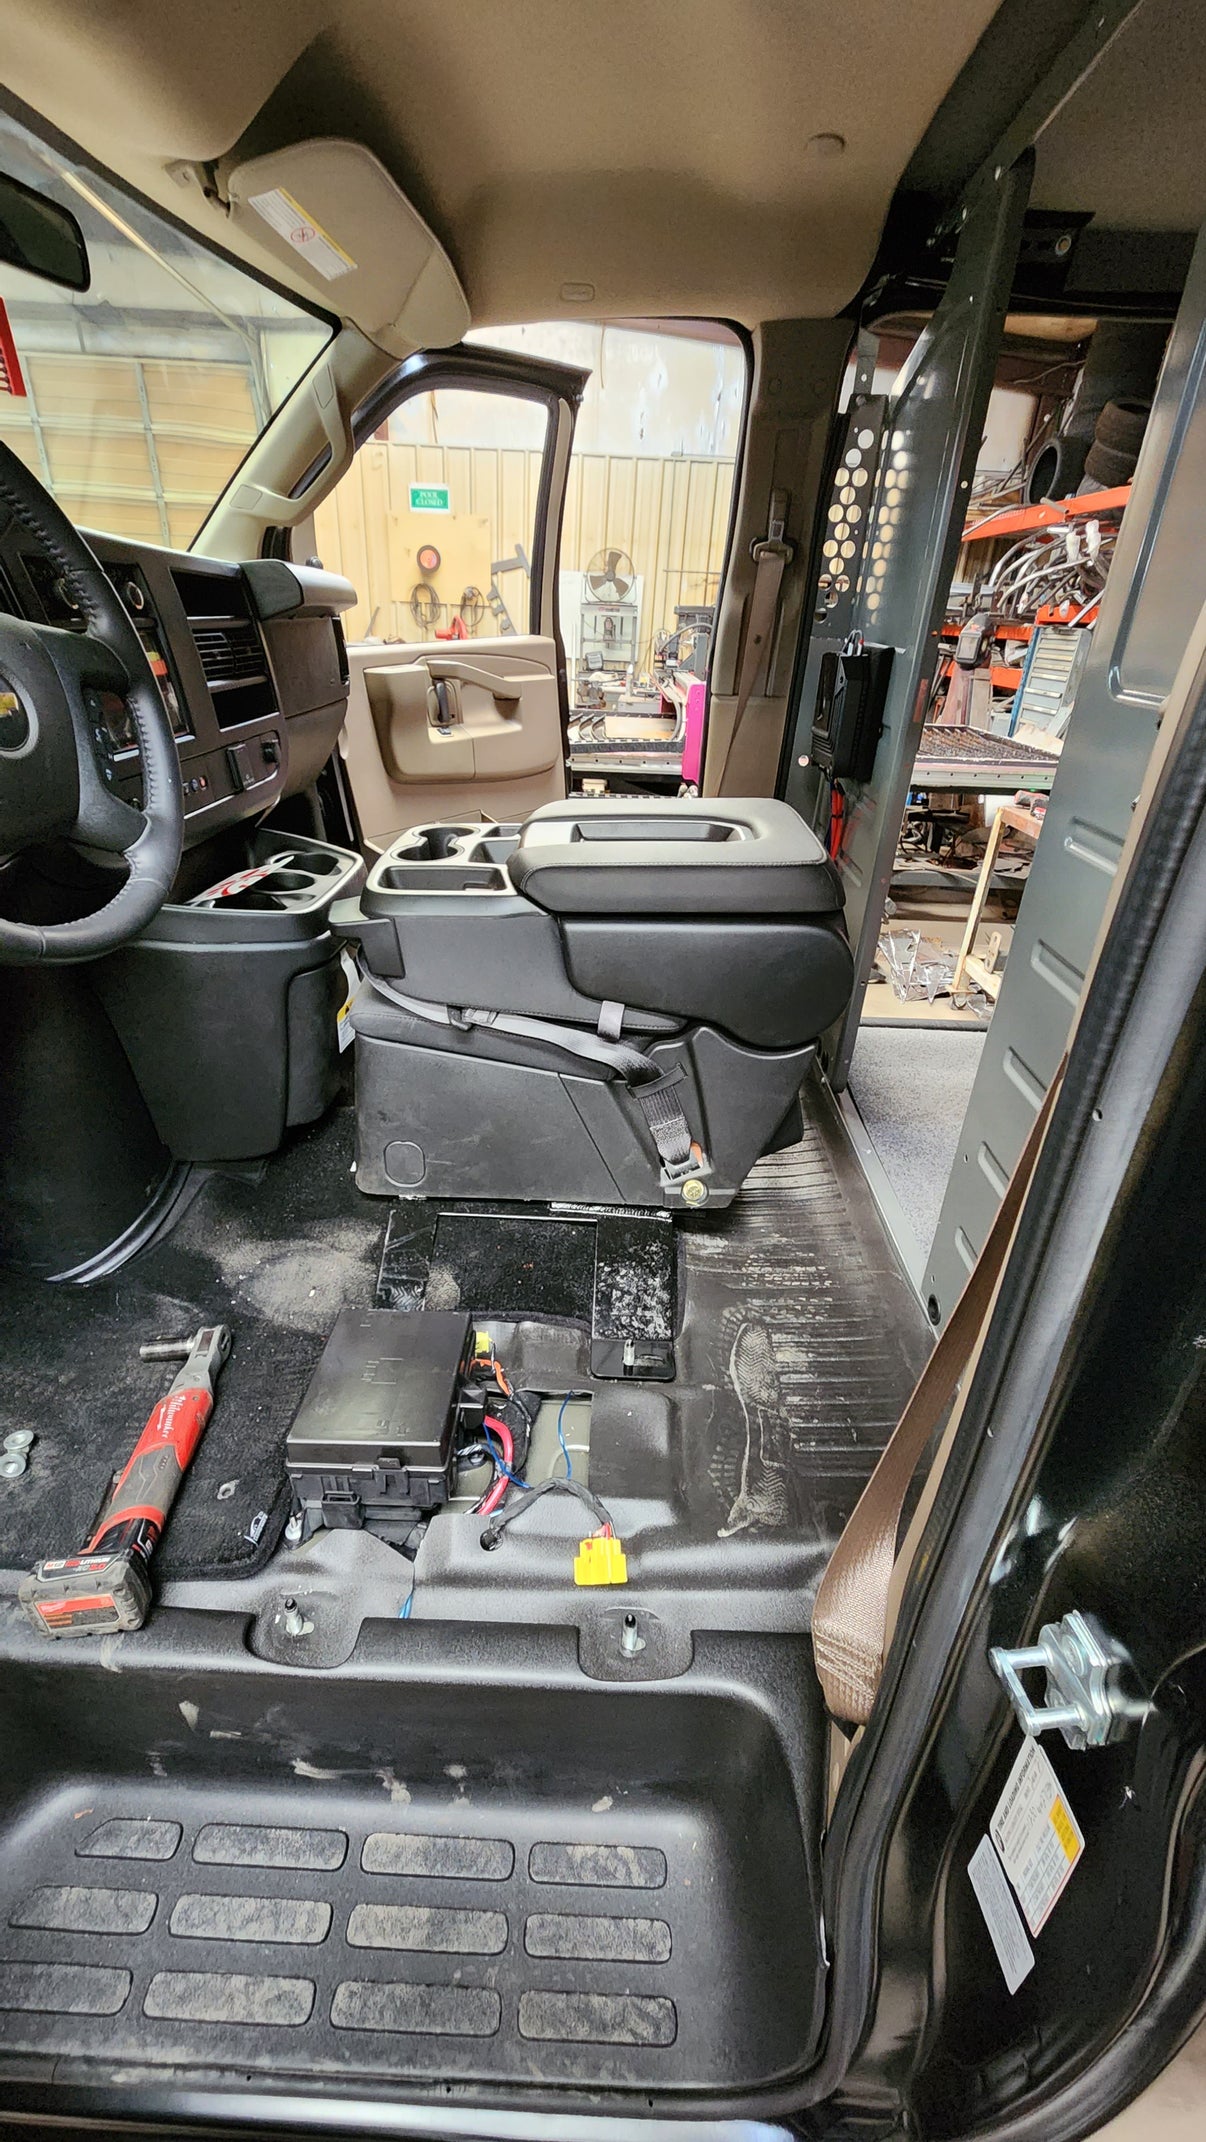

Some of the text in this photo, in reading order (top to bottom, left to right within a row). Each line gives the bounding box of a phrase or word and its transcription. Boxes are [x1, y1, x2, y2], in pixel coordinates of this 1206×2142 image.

[162, 1395, 186, 1438] Milwaukee
[1008, 1782, 1020, 1809] LOADING
[1018, 1745, 1035, 1785] INFORMATION
